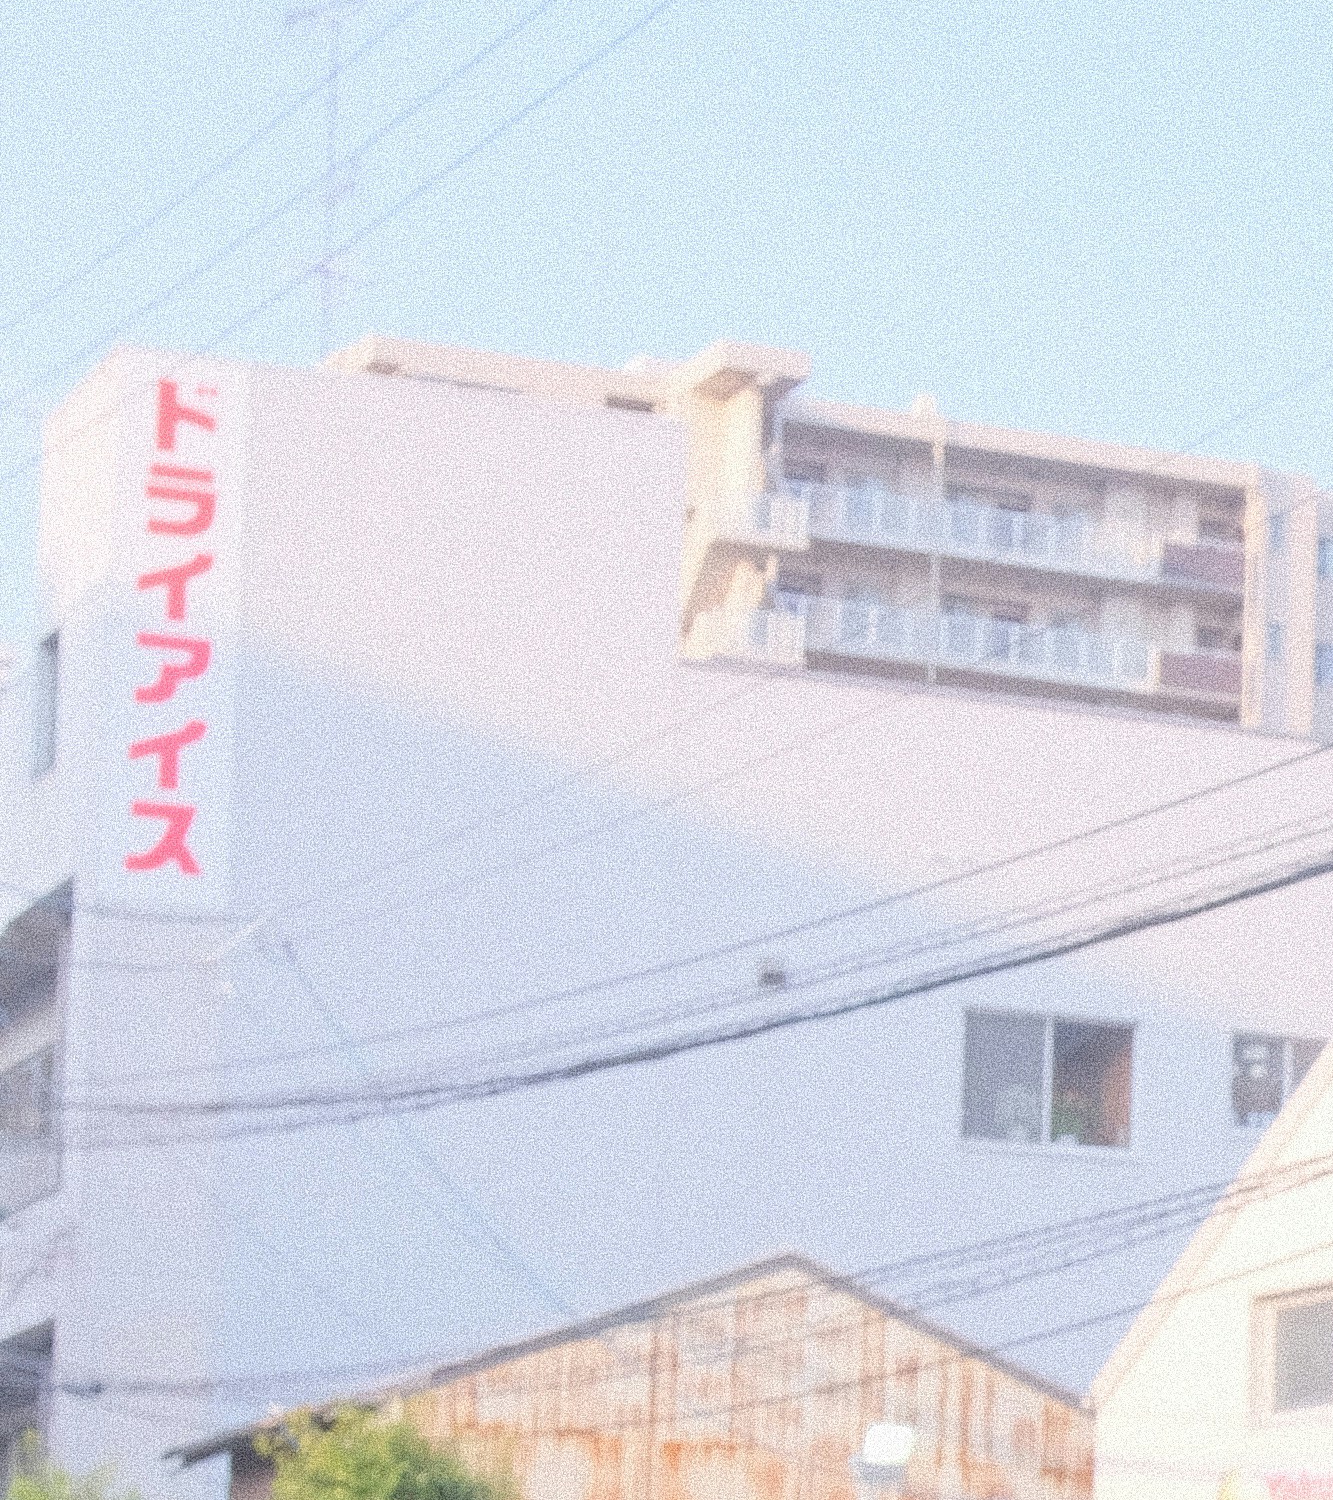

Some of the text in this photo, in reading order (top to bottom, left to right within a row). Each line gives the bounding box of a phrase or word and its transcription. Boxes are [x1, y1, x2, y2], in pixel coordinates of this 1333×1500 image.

[122, 376, 220, 877] ドライアイス
